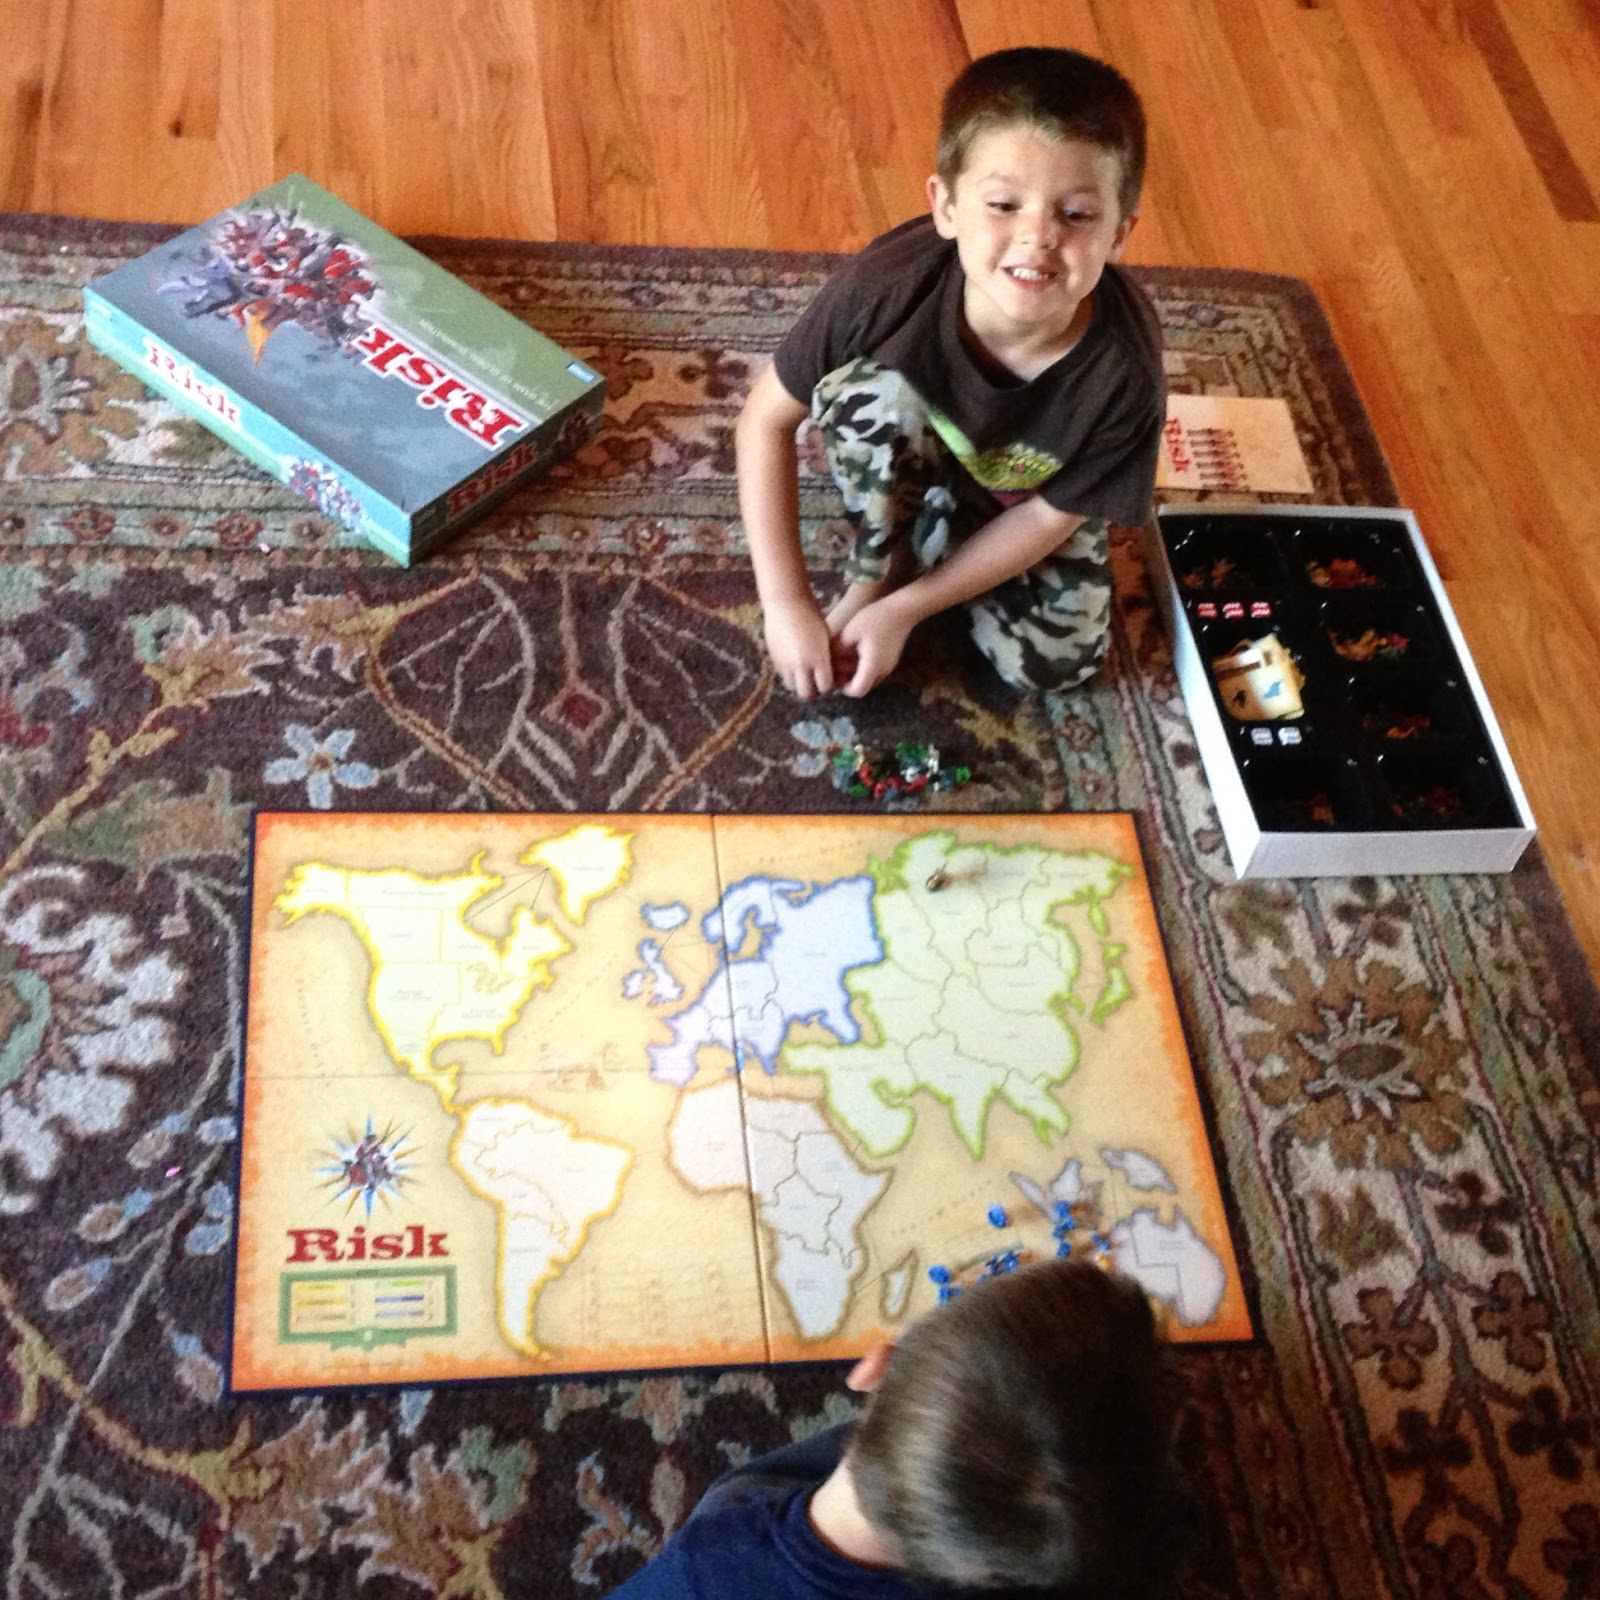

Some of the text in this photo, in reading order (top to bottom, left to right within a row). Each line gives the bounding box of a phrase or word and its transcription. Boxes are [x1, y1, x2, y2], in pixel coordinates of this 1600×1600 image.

[147, 342, 239, 426] Risk
[355, 325, 524, 448] Risk
[446, 440, 538, 520] Risk
[285, 1224, 450, 1264] Risk
